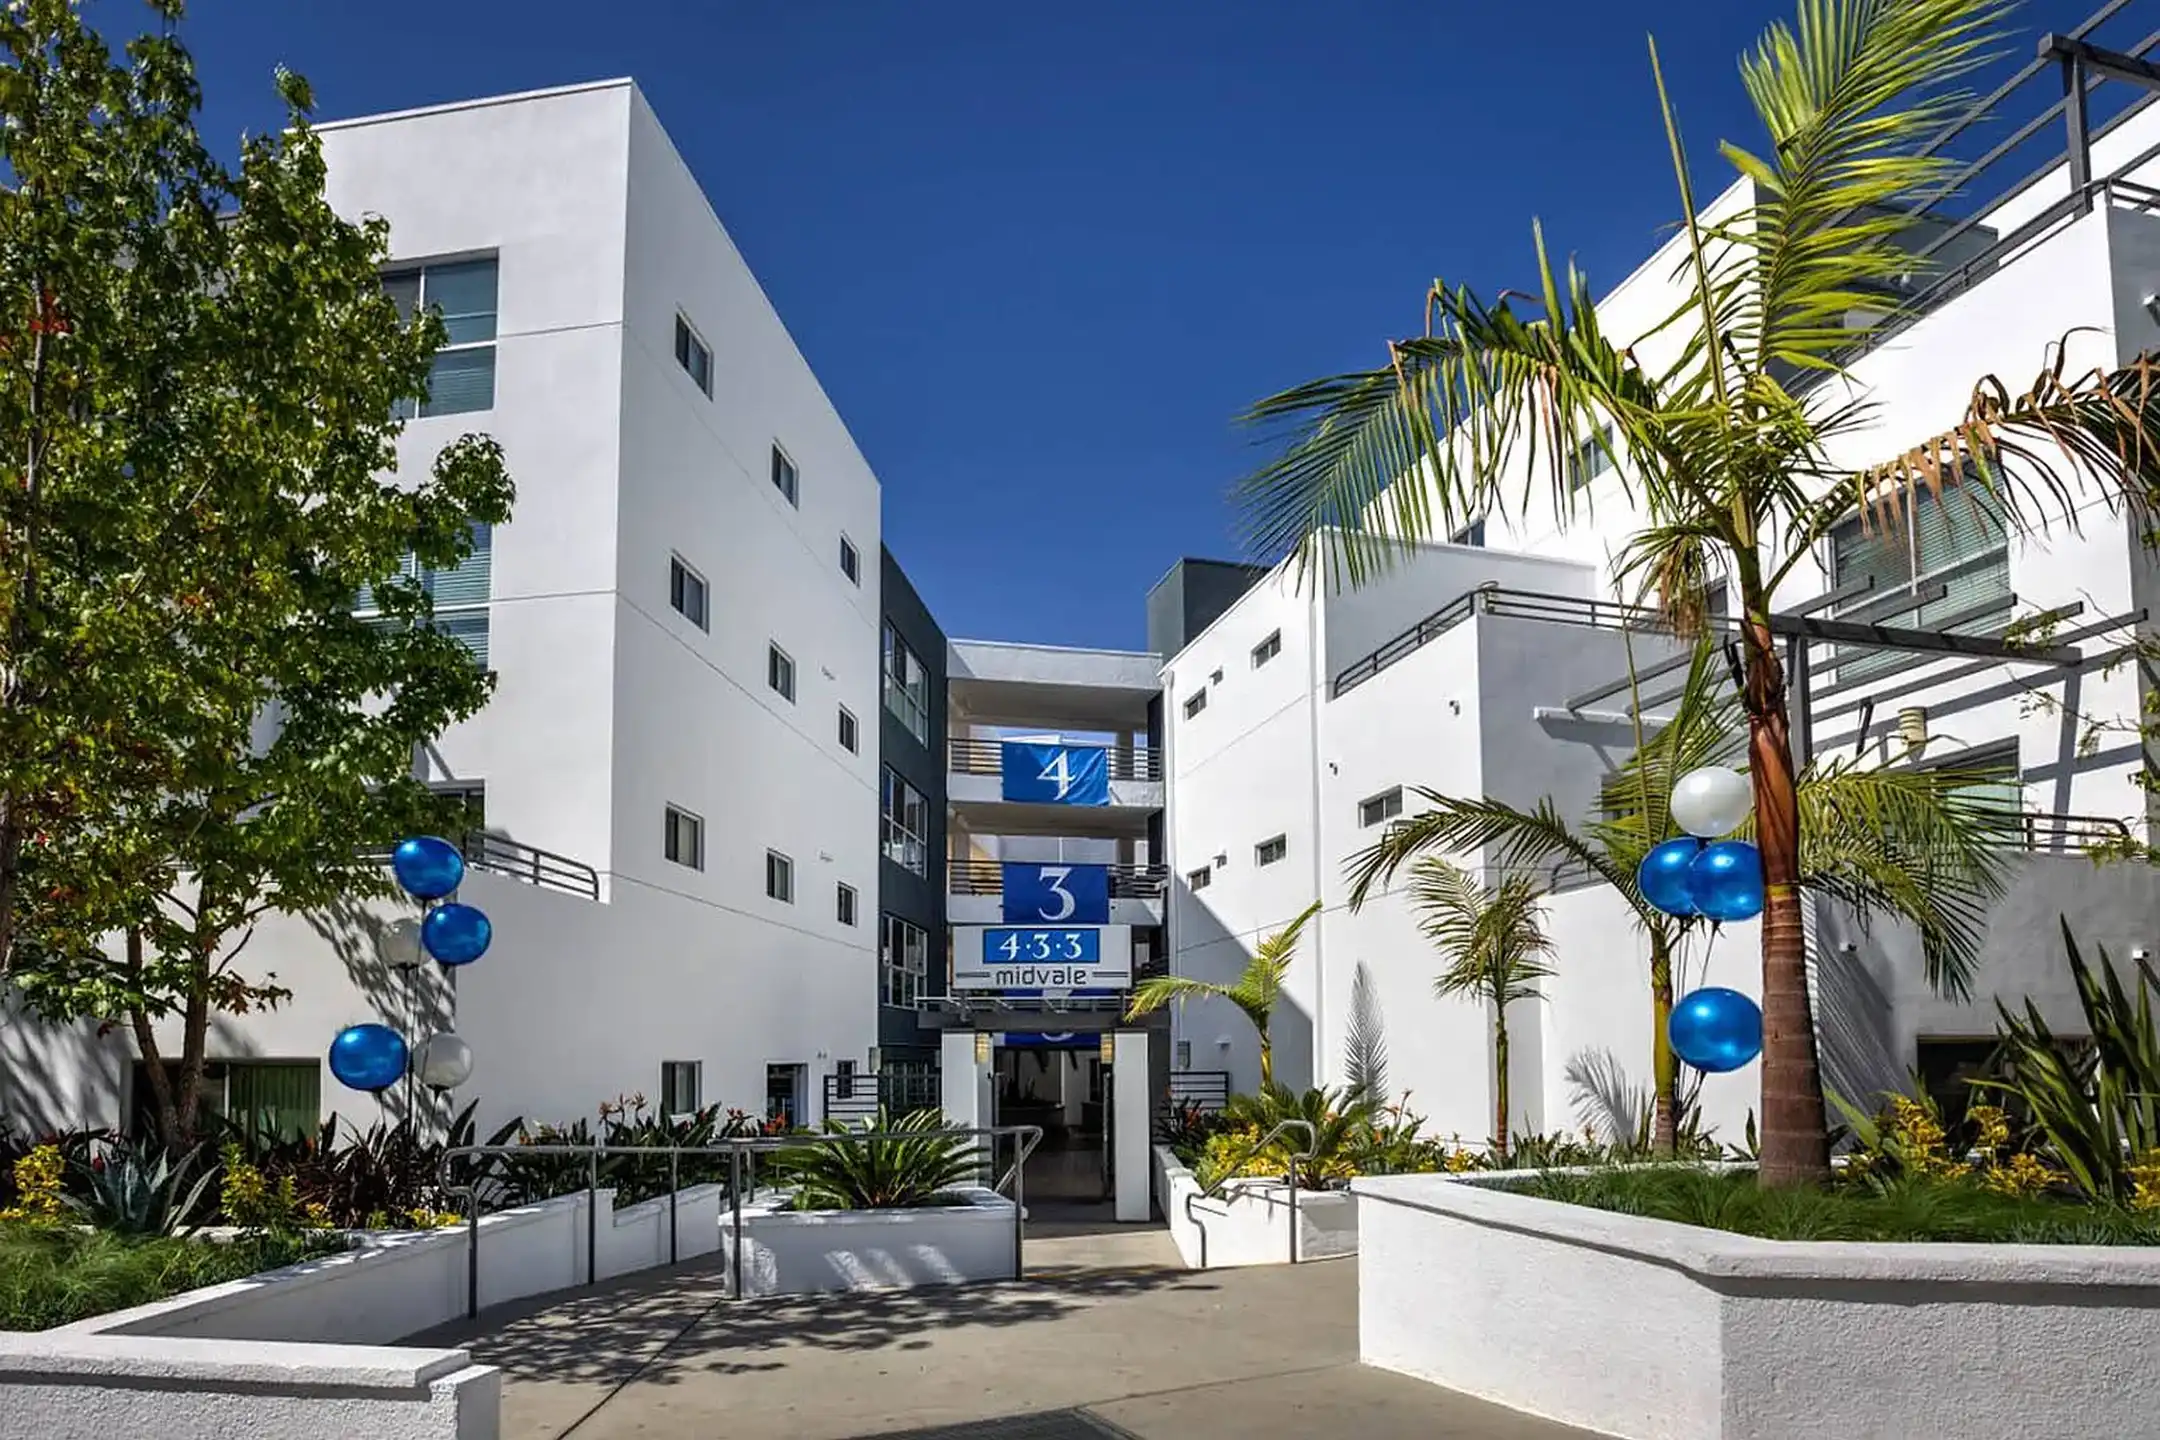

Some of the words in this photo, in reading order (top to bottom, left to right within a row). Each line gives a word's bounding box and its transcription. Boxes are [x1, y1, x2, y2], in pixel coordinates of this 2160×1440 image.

[1037, 750, 1075, 800] 4
[1039, 866, 1075, 920] 3
[996, 966, 1087, 985] midvale
